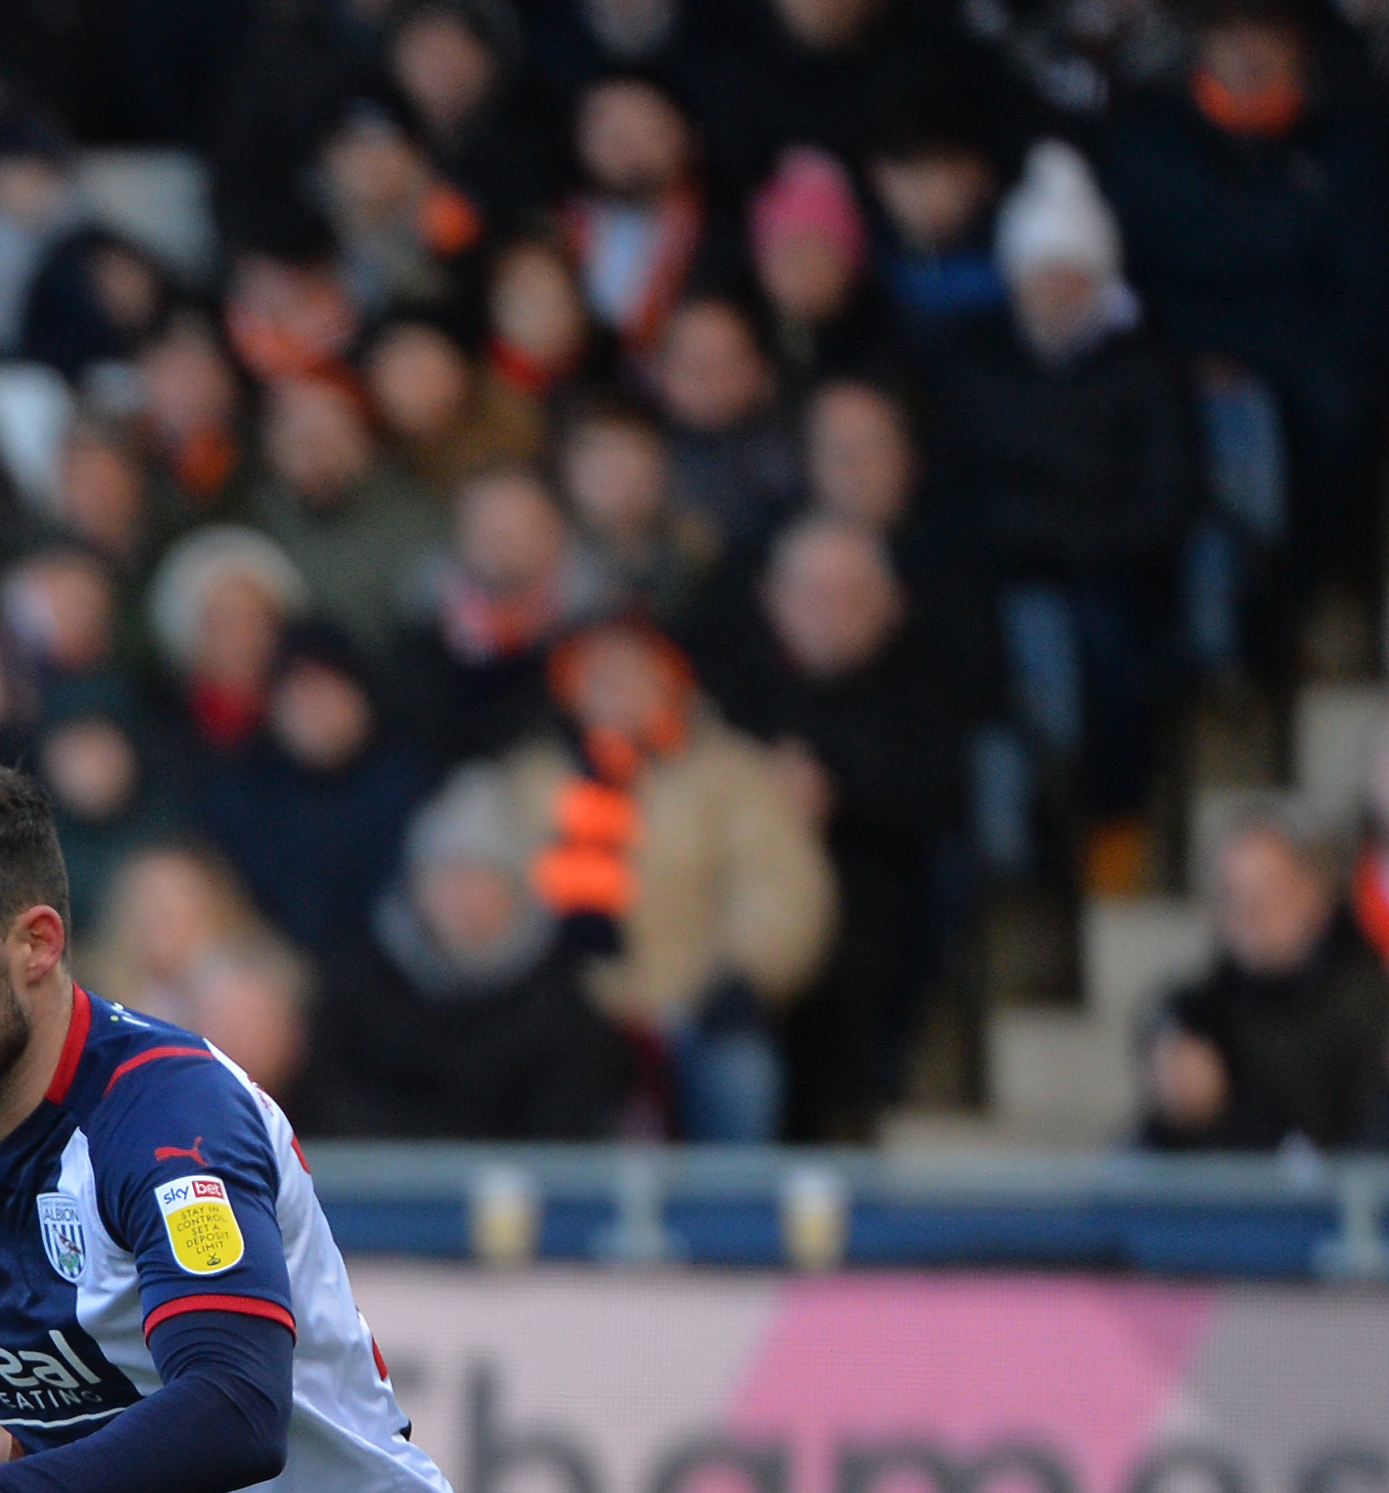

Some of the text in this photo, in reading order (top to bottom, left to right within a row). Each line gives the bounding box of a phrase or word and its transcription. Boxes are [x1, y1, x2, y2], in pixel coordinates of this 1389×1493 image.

[163, 1183, 222, 1205] sky bet
[44, 1207, 79, 1221] ALBION
[181, 1206, 205, 1220] STAY
[176, 1214, 226, 1232] CONTROL
[191, 1225, 208, 1236] SET
[186, 1231, 229, 1248] DEPOSIT
[195, 1241, 223, 1254] LIMIT
